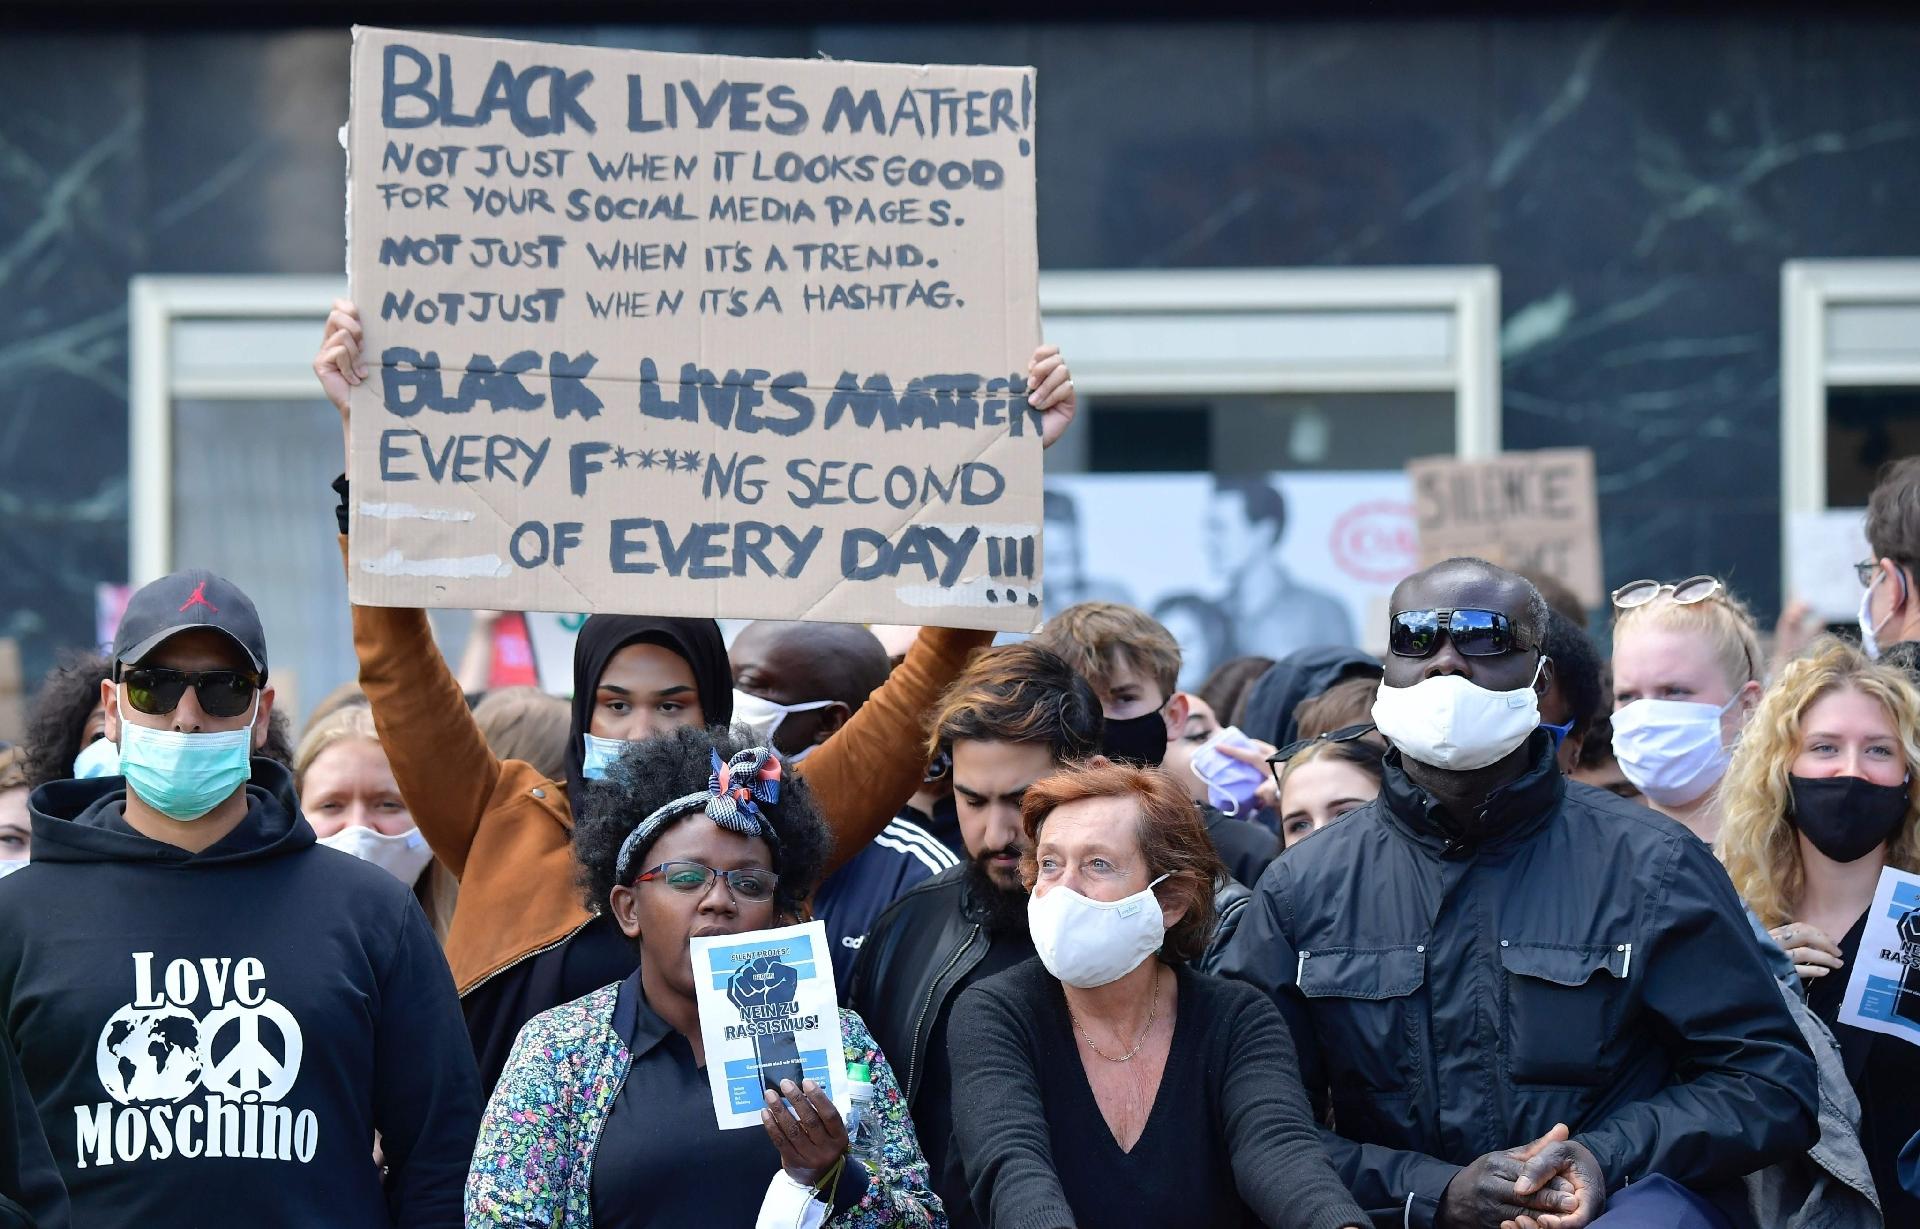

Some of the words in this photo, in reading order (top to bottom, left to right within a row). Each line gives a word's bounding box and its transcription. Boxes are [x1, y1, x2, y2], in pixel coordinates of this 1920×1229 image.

[381, 44, 598, 137] BLACK
[626, 73, 810, 136] LIVES
[821, 74, 1033, 160] MATTER!
[382, 140, 468, 178] NOT
[474, 146, 575, 179] JUST
[587, 151, 698, 183] WHEN
[713, 151, 745, 183] IT
[752, 150, 879, 184] LOOKS
[882, 155, 1004, 191] GOOD
[377, 182, 450, 210] FOR
[463, 186, 556, 218] YOUR
[565, 188, 698, 223] SOCIAL
[708, 194, 816, 225] MEDIA
[824, 195, 965, 227] PAGES.
[378, 233, 463, 267] NOT
[469, 234, 567, 269] JUST
[585, 239, 687, 272] WHEN
[705, 240, 753, 273] IT'S
[764, 244, 788, 273] A
[792, 242, 939, 272] TREND.
[380, 289, 465, 326] NOT
[468, 288, 566, 324] JUST
[585, 289, 684, 319] WHEN
[699, 288, 748, 318] IT'S
[754, 286, 783, 313] A
[803, 279, 965, 313] HASHTAG.
[379, 346, 605, 422] BLACK
[638, 357, 816, 438] LIVES
[823, 370, 1044, 438] MATTER
[379, 428, 552, 488] EVERY
[785, 458, 1006, 510] SECOND
[509, 520, 585, 570] OF
[609, 517, 825, 580] EVERY
[131, 951, 266, 1007] Love
[723, 1015, 819, 1041] RASSISMUS!
[739, 1003, 777, 1021] NEIN
[779, 1000, 800, 1016] ZU
[74, 1093, 319, 1168] Moschino
